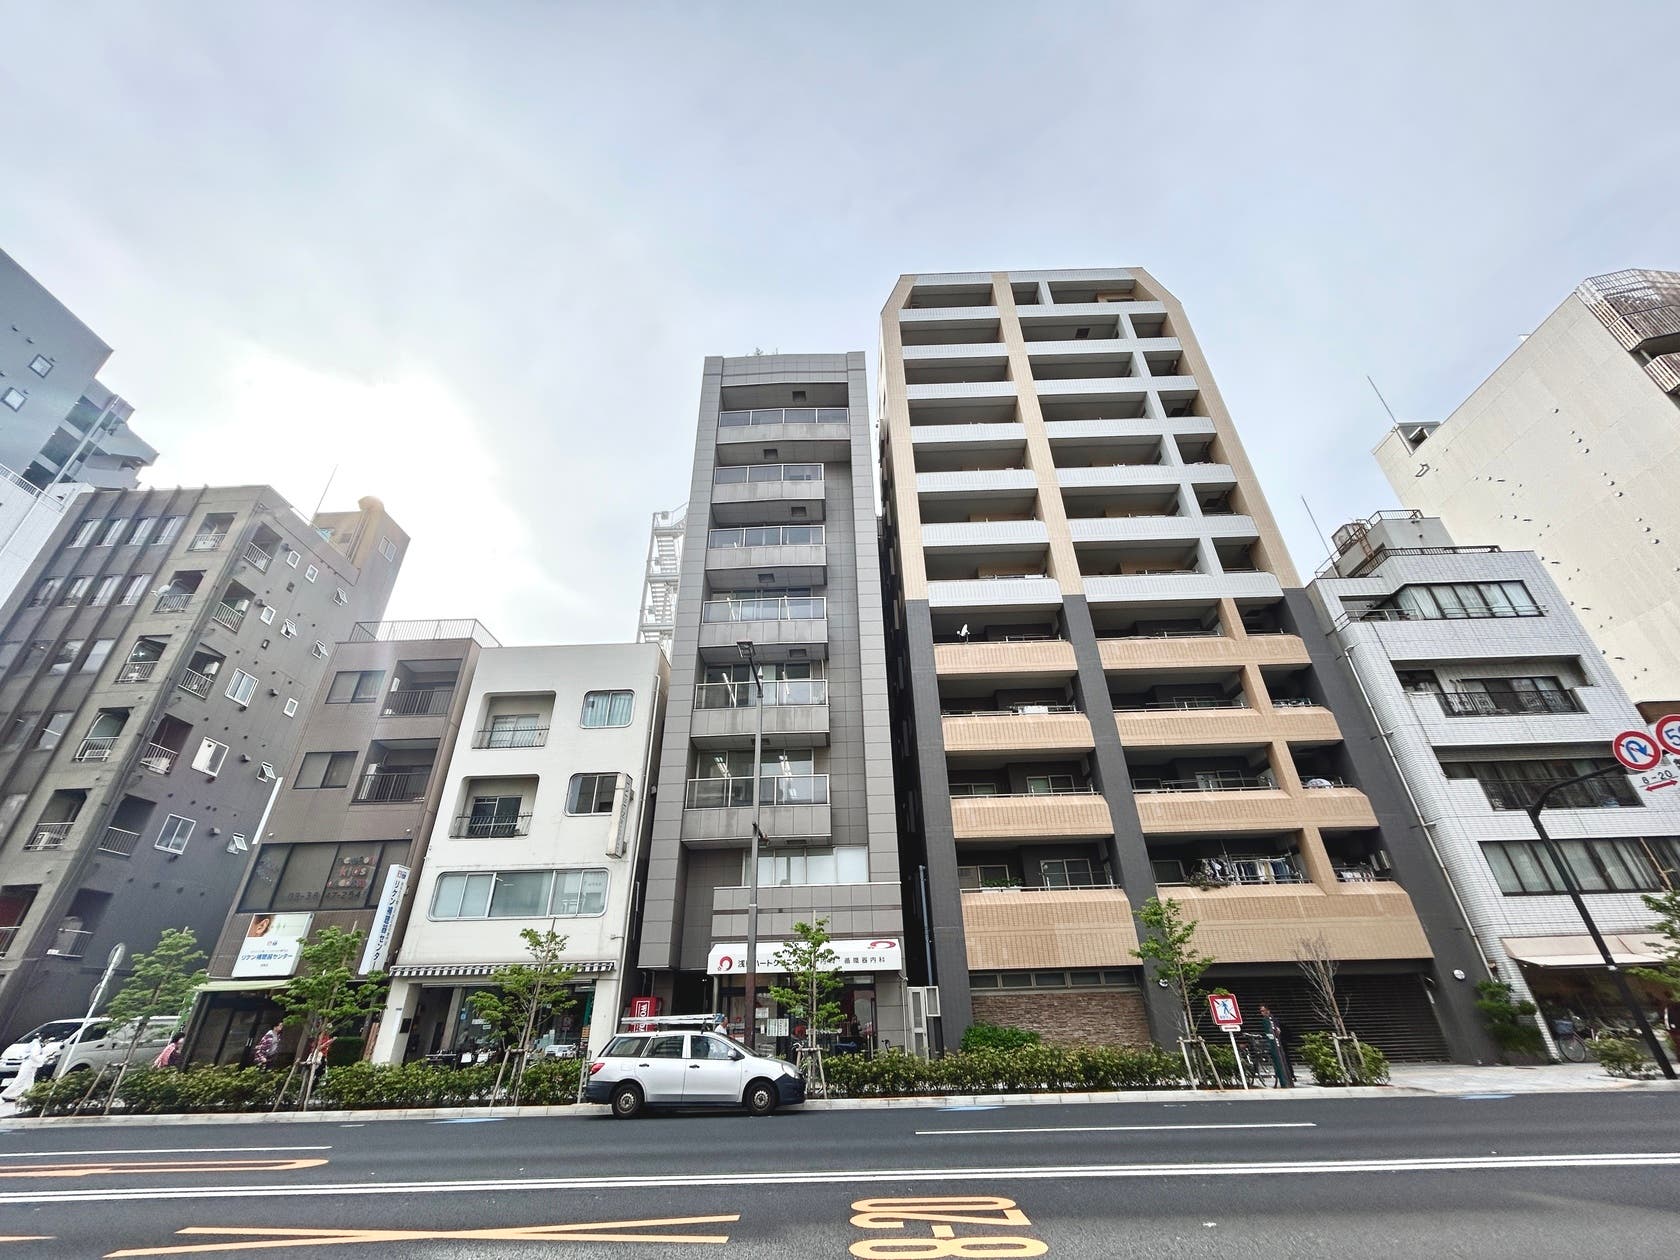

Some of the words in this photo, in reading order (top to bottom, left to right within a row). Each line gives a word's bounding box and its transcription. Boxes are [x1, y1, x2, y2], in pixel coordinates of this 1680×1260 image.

[1664, 726, 1680, 746] 5
[1642, 770, 1672, 784] 8-20
[849, 1196, 1049, 1260] 8-20
